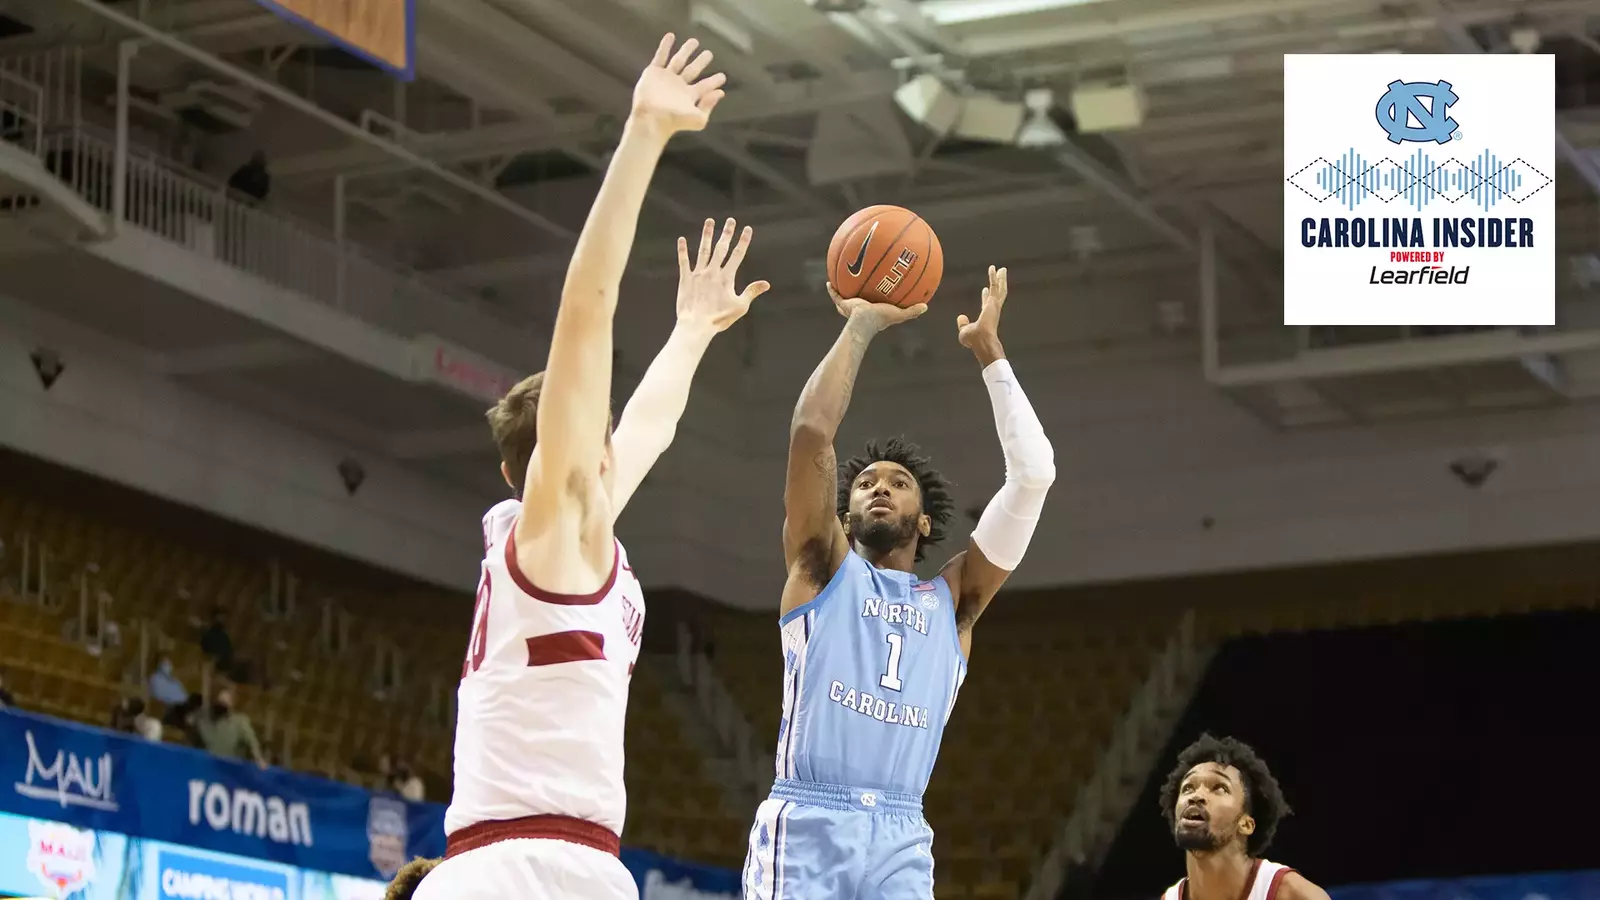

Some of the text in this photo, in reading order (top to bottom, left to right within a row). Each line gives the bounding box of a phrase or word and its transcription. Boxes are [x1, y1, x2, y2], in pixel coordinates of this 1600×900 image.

[875, 246, 916, 297] ELITE
[861, 598, 928, 636] NORTH
[878, 632, 906, 693] 1
[828, 679, 929, 730] CAROLINA
[24, 729, 113, 809] MAUI
[188, 779, 314, 847] roman
